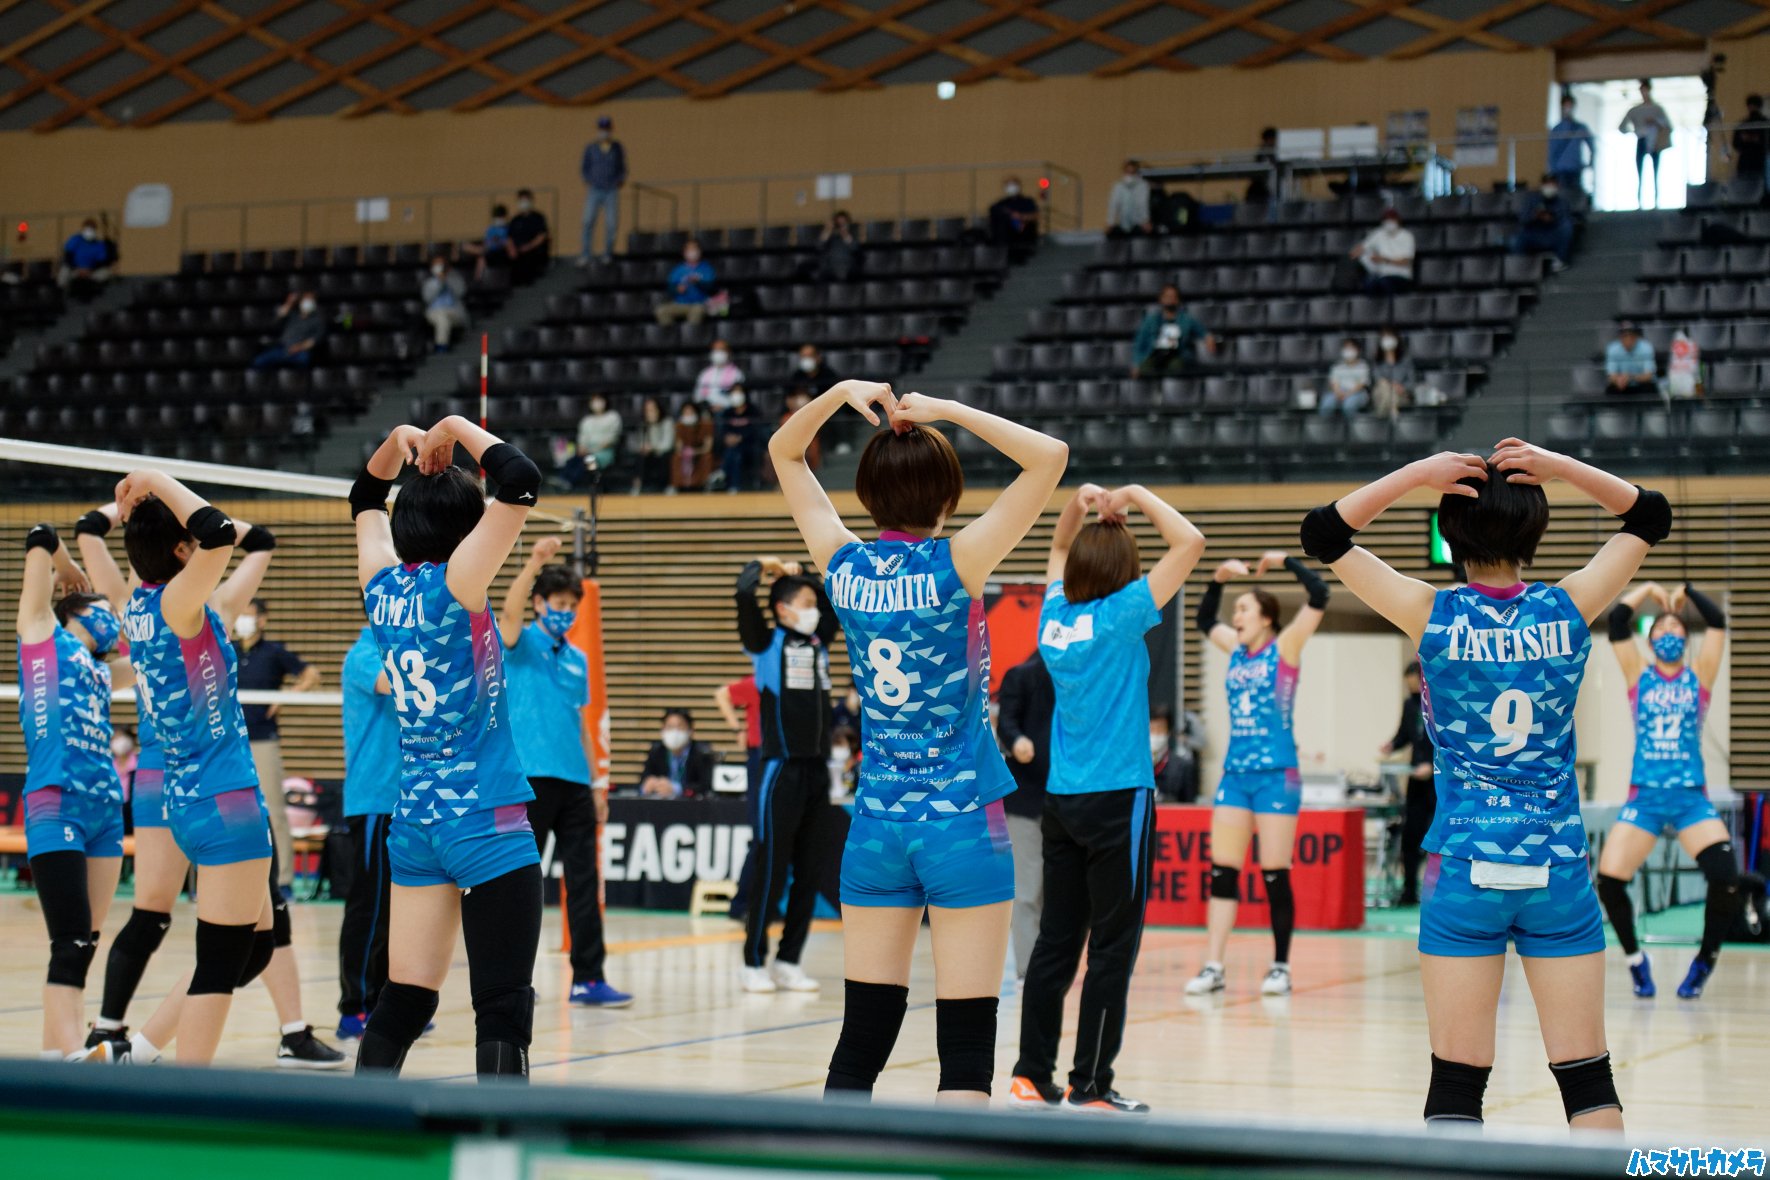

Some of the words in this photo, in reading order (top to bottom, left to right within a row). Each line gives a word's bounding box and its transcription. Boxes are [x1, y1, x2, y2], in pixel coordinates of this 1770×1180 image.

[1446, 619, 1573, 663] TATEISHI
[385, 650, 437, 712] 13
[867, 638, 911, 706] 8
[31, 657, 48, 740] KUROBE
[200, 650, 226, 740] KUROBE
[1642, 687, 1694, 708] AQUA
[895, 732, 924, 740] TOYOX
[1490, 689, 1533, 757] 9
[1650, 713, 1682, 740] 12
[63, 826, 75, 843] 5
[1148, 871, 1189, 902] HE
